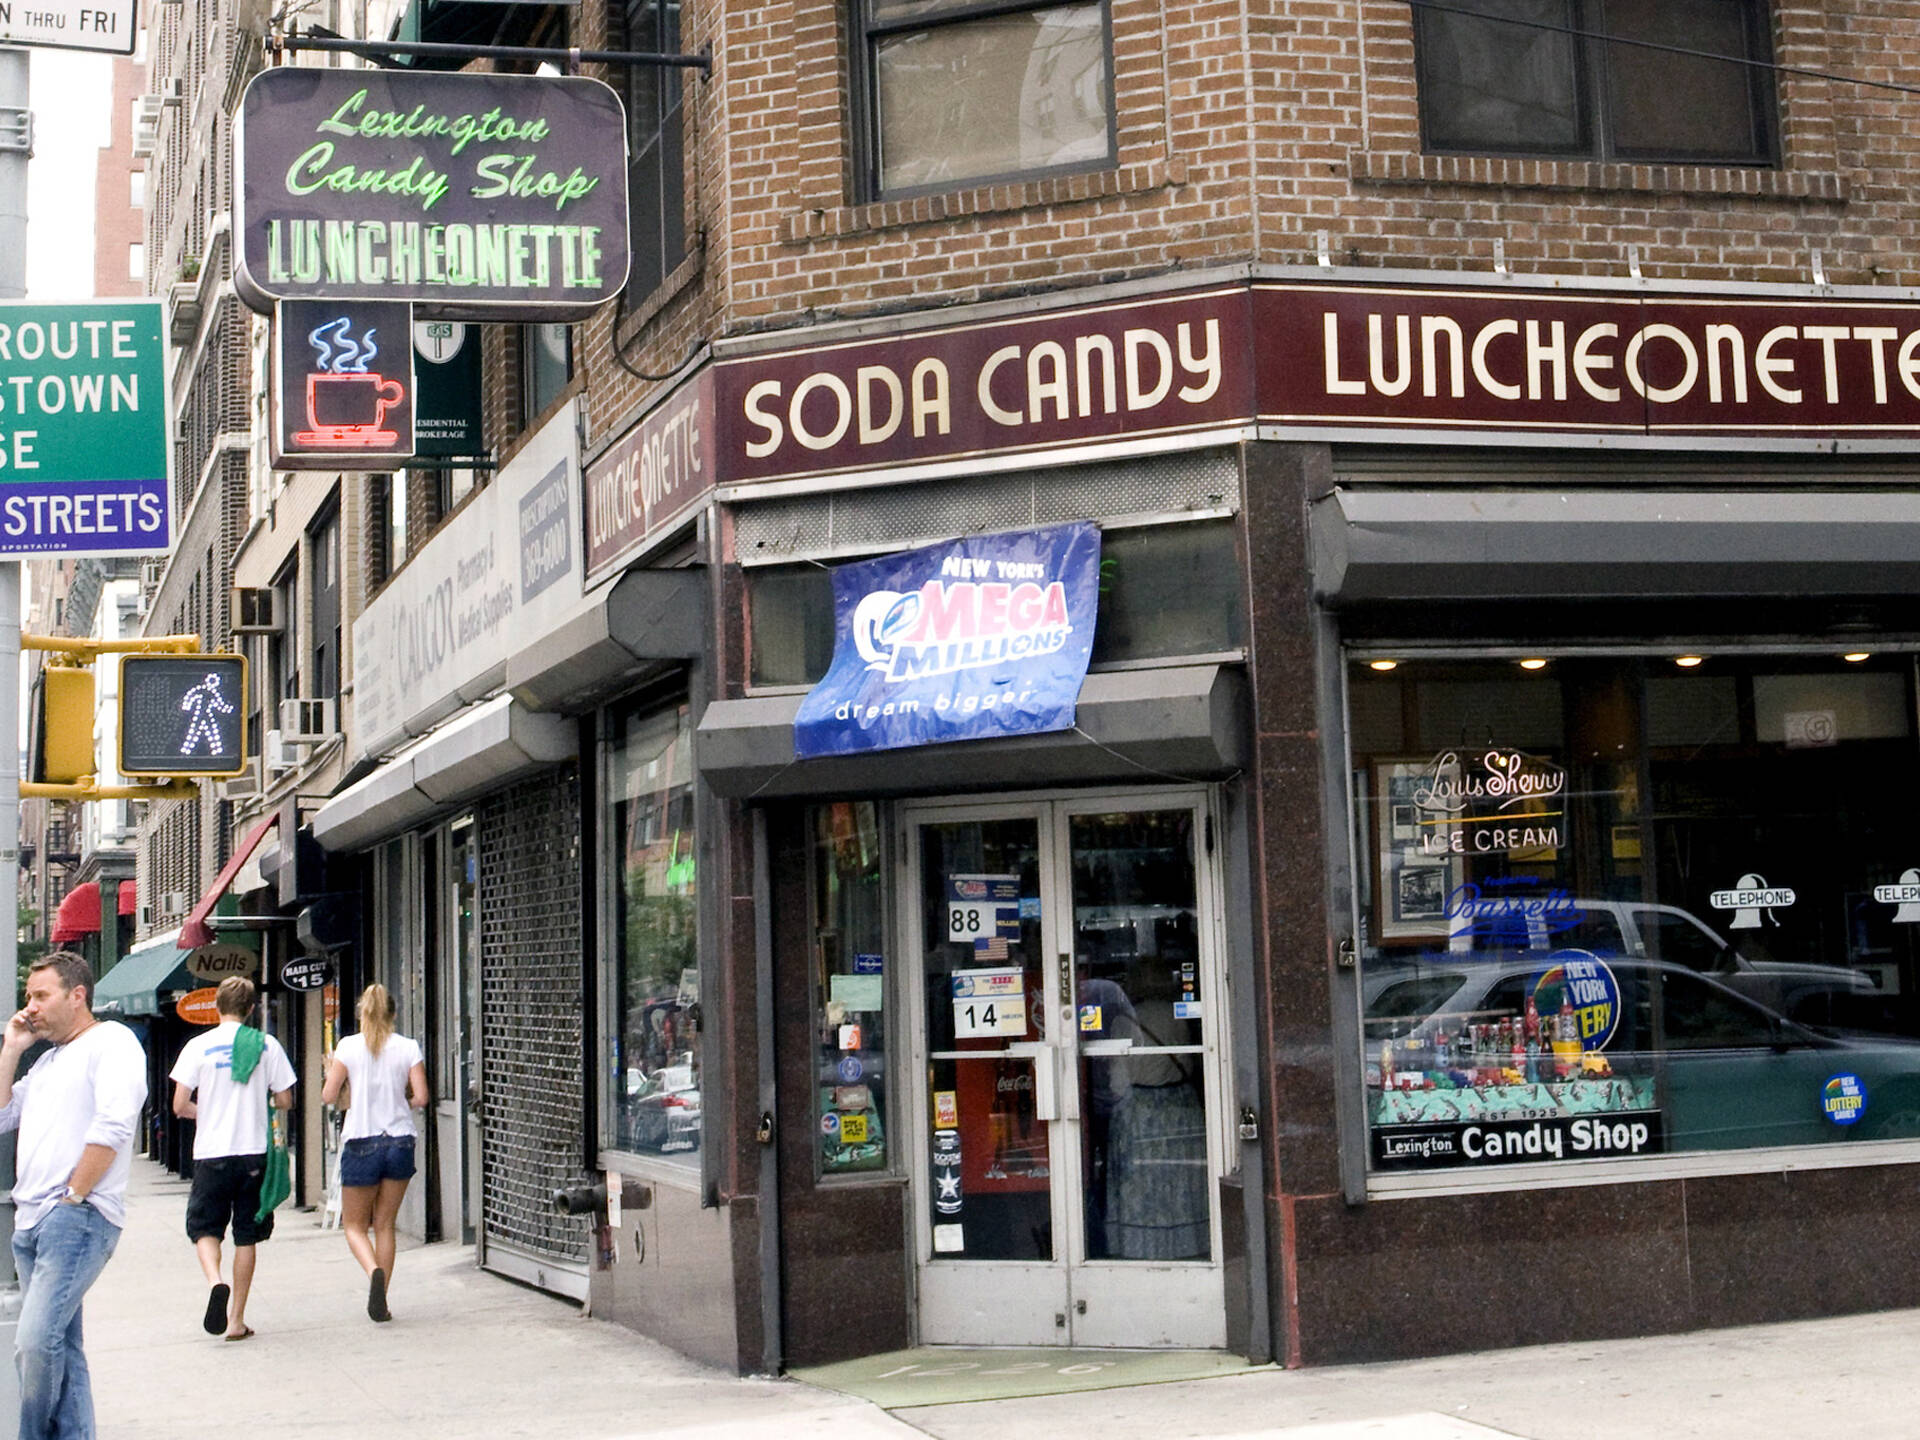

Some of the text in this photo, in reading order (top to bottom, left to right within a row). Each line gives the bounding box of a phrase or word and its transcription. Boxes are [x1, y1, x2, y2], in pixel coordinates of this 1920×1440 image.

[25, 11, 65, 29] THRU
[80, 9, 116, 33] FRI
[317, 89, 549, 155] Lexington
[286, 141, 598, 210] Candy Shop
[268, 219, 603, 288] LUNCHEONETTE
[0, 374, 139, 415] TOWN
[744, 319, 1222, 458] SODA CANDY
[416, 419, 468, 427] ESIDENTIAL
[592, 399, 702, 548] LUNCHEONETTE
[4, 493, 161, 536] STREETS
[941, 556, 1044, 578] NEW YORK'S
[903, 580, 1068, 643] MEGA
[891, 629, 1065, 677] MILLIONS
[835, 690, 1030, 720] dream bigger
[1414, 751, 1564, 811] Louis Sherry
[1424, 827, 1558, 853] ICE CREAM
[1713, 890, 1792, 906] TELEPHONE
[1876, 887, 1920, 901] TELEP
[951, 909, 980, 932] 88
[196, 954, 247, 972] Nails
[286, 962, 327, 976] HAIR CUT
[1565, 961, 1598, 979] NEW
[1569, 979, 1608, 1005] YORK
[965, 1004, 997, 1028] 14
[1479, 1108, 1558, 1121] EST 1925
[1825, 1095, 1863, 1112] LOTTERY
[1385, 1118, 1649, 1159] Lexington Candy Shop
